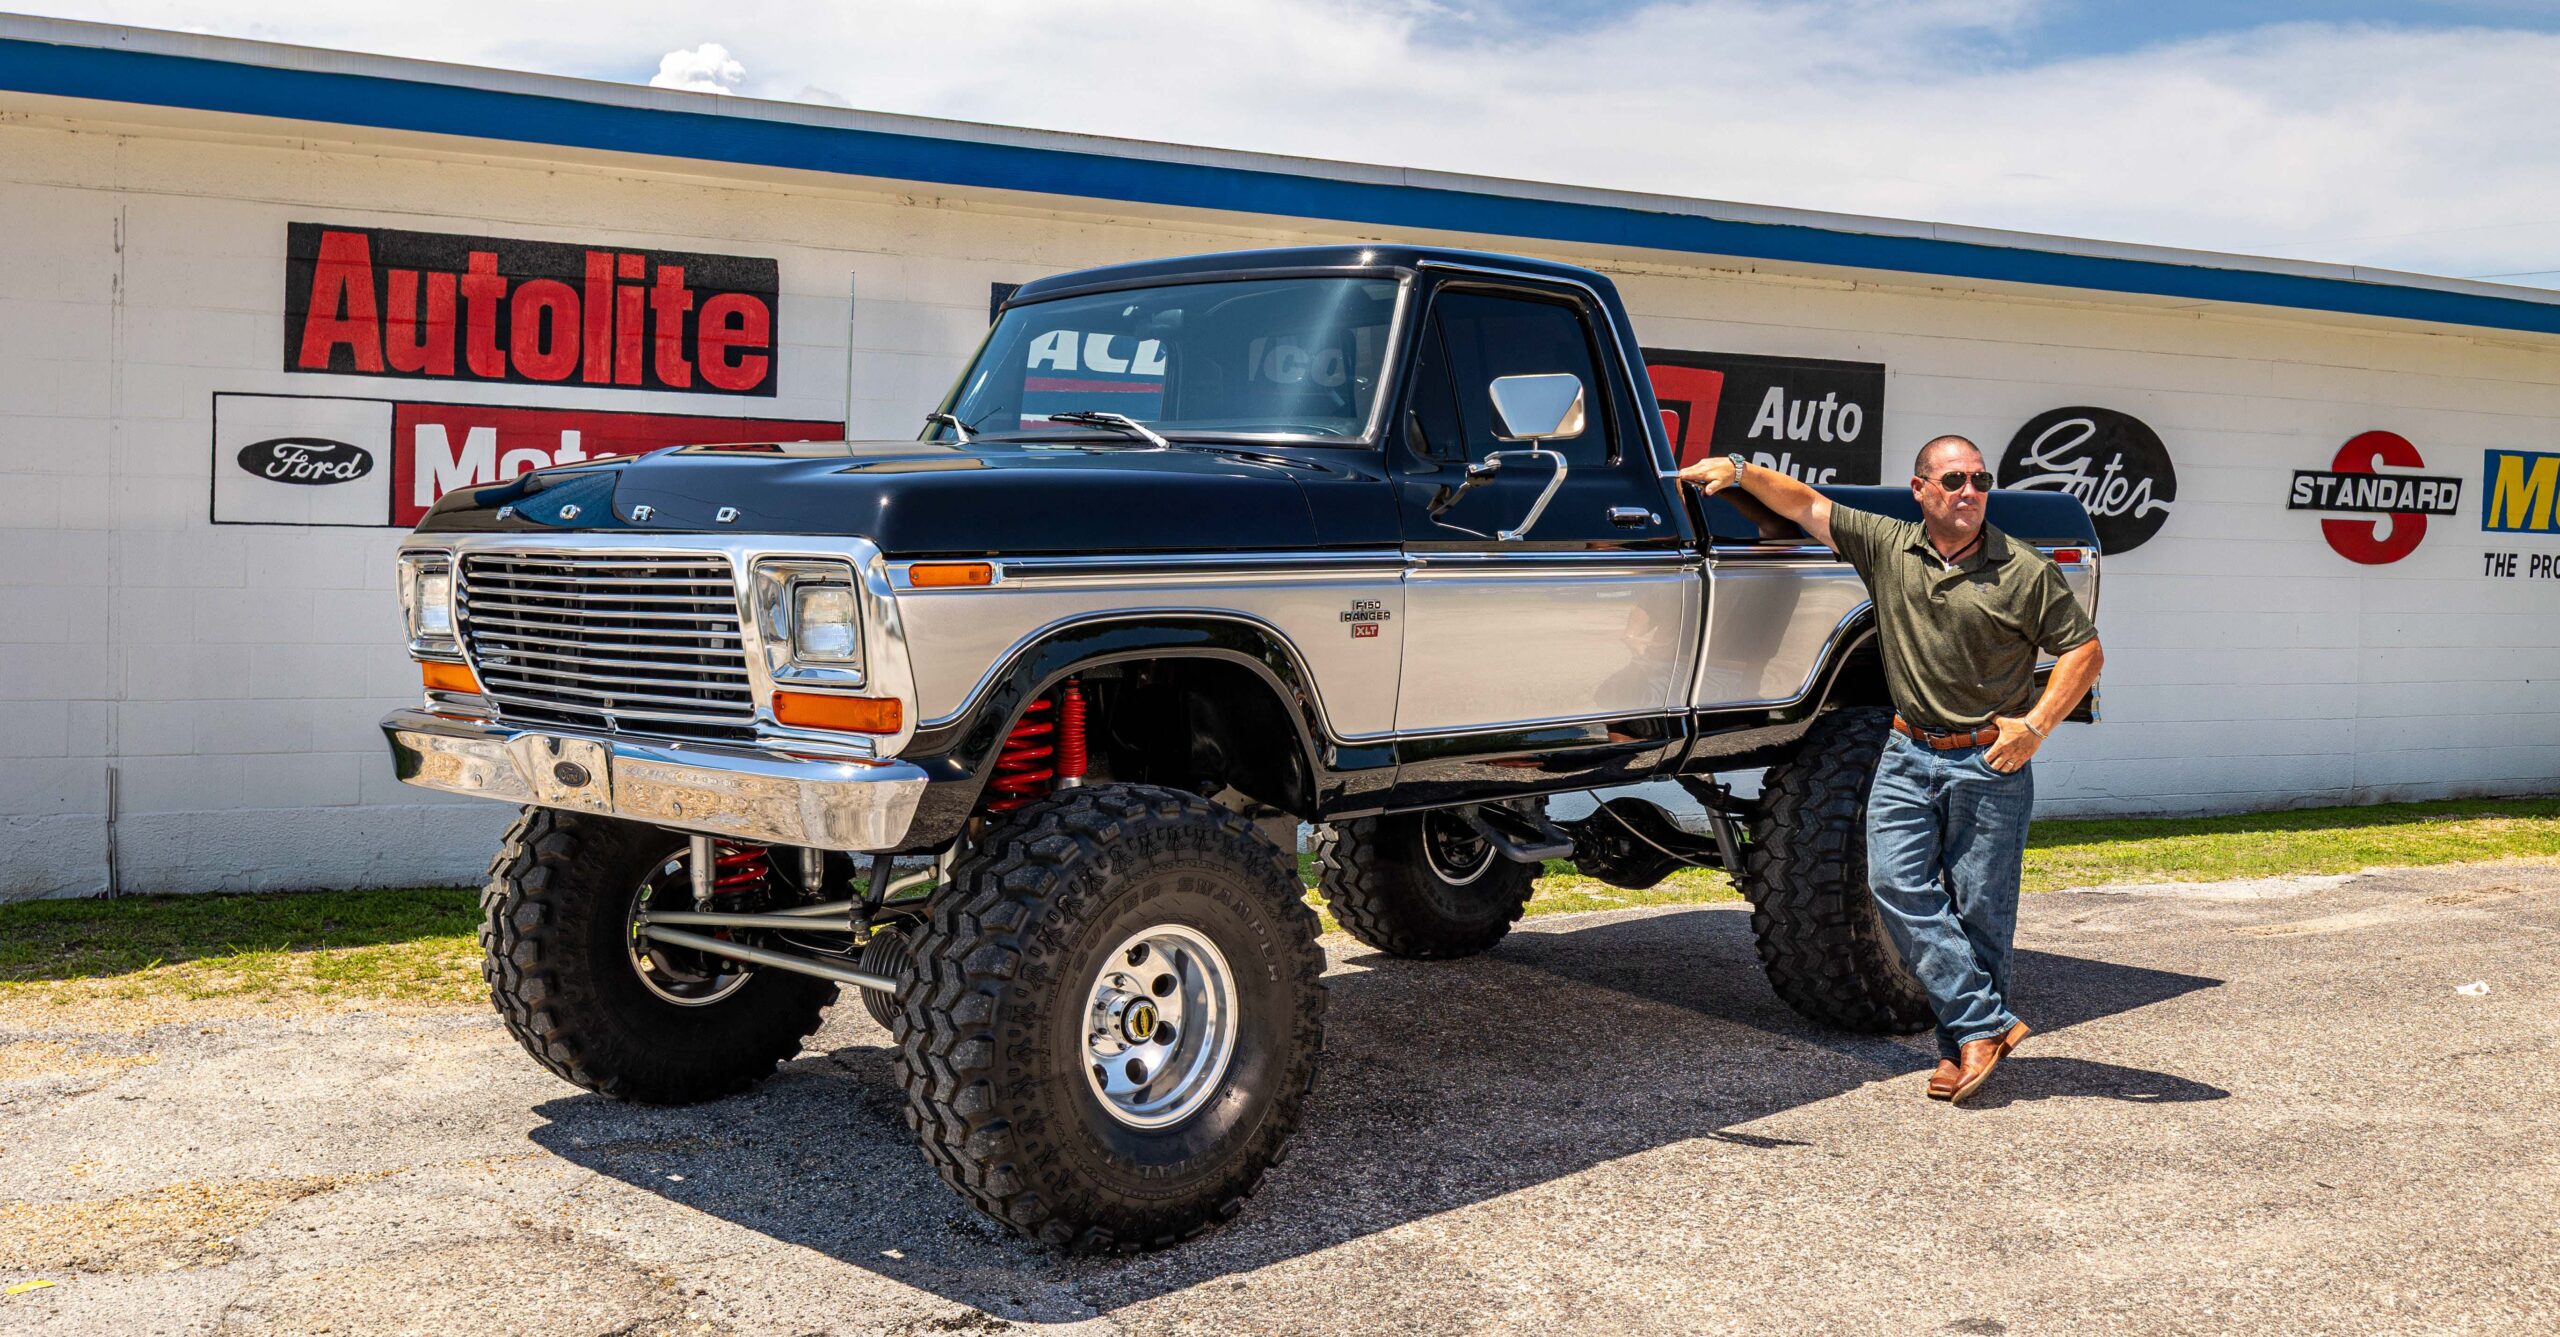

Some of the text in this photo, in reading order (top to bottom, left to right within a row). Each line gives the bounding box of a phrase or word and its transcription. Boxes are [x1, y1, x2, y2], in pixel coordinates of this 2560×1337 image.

[298, 230, 770, 389] Autolite
[1747, 386, 1863, 442] Auto
[265, 442, 362, 483] Ford
[2006, 418, 2175, 519] Gates
[2292, 475, 2459, 511] STANDARD
[2487, 454, 2560, 530] M
[496, 504, 741, 524] FORD
[2484, 552, 2518, 578] THE
[1343, 611, 1391, 622] RANGER
[1355, 600, 1382, 610] F150
[1355, 625, 1378, 636] XLT
[1175, 876, 1281, 983] SWAMPER
